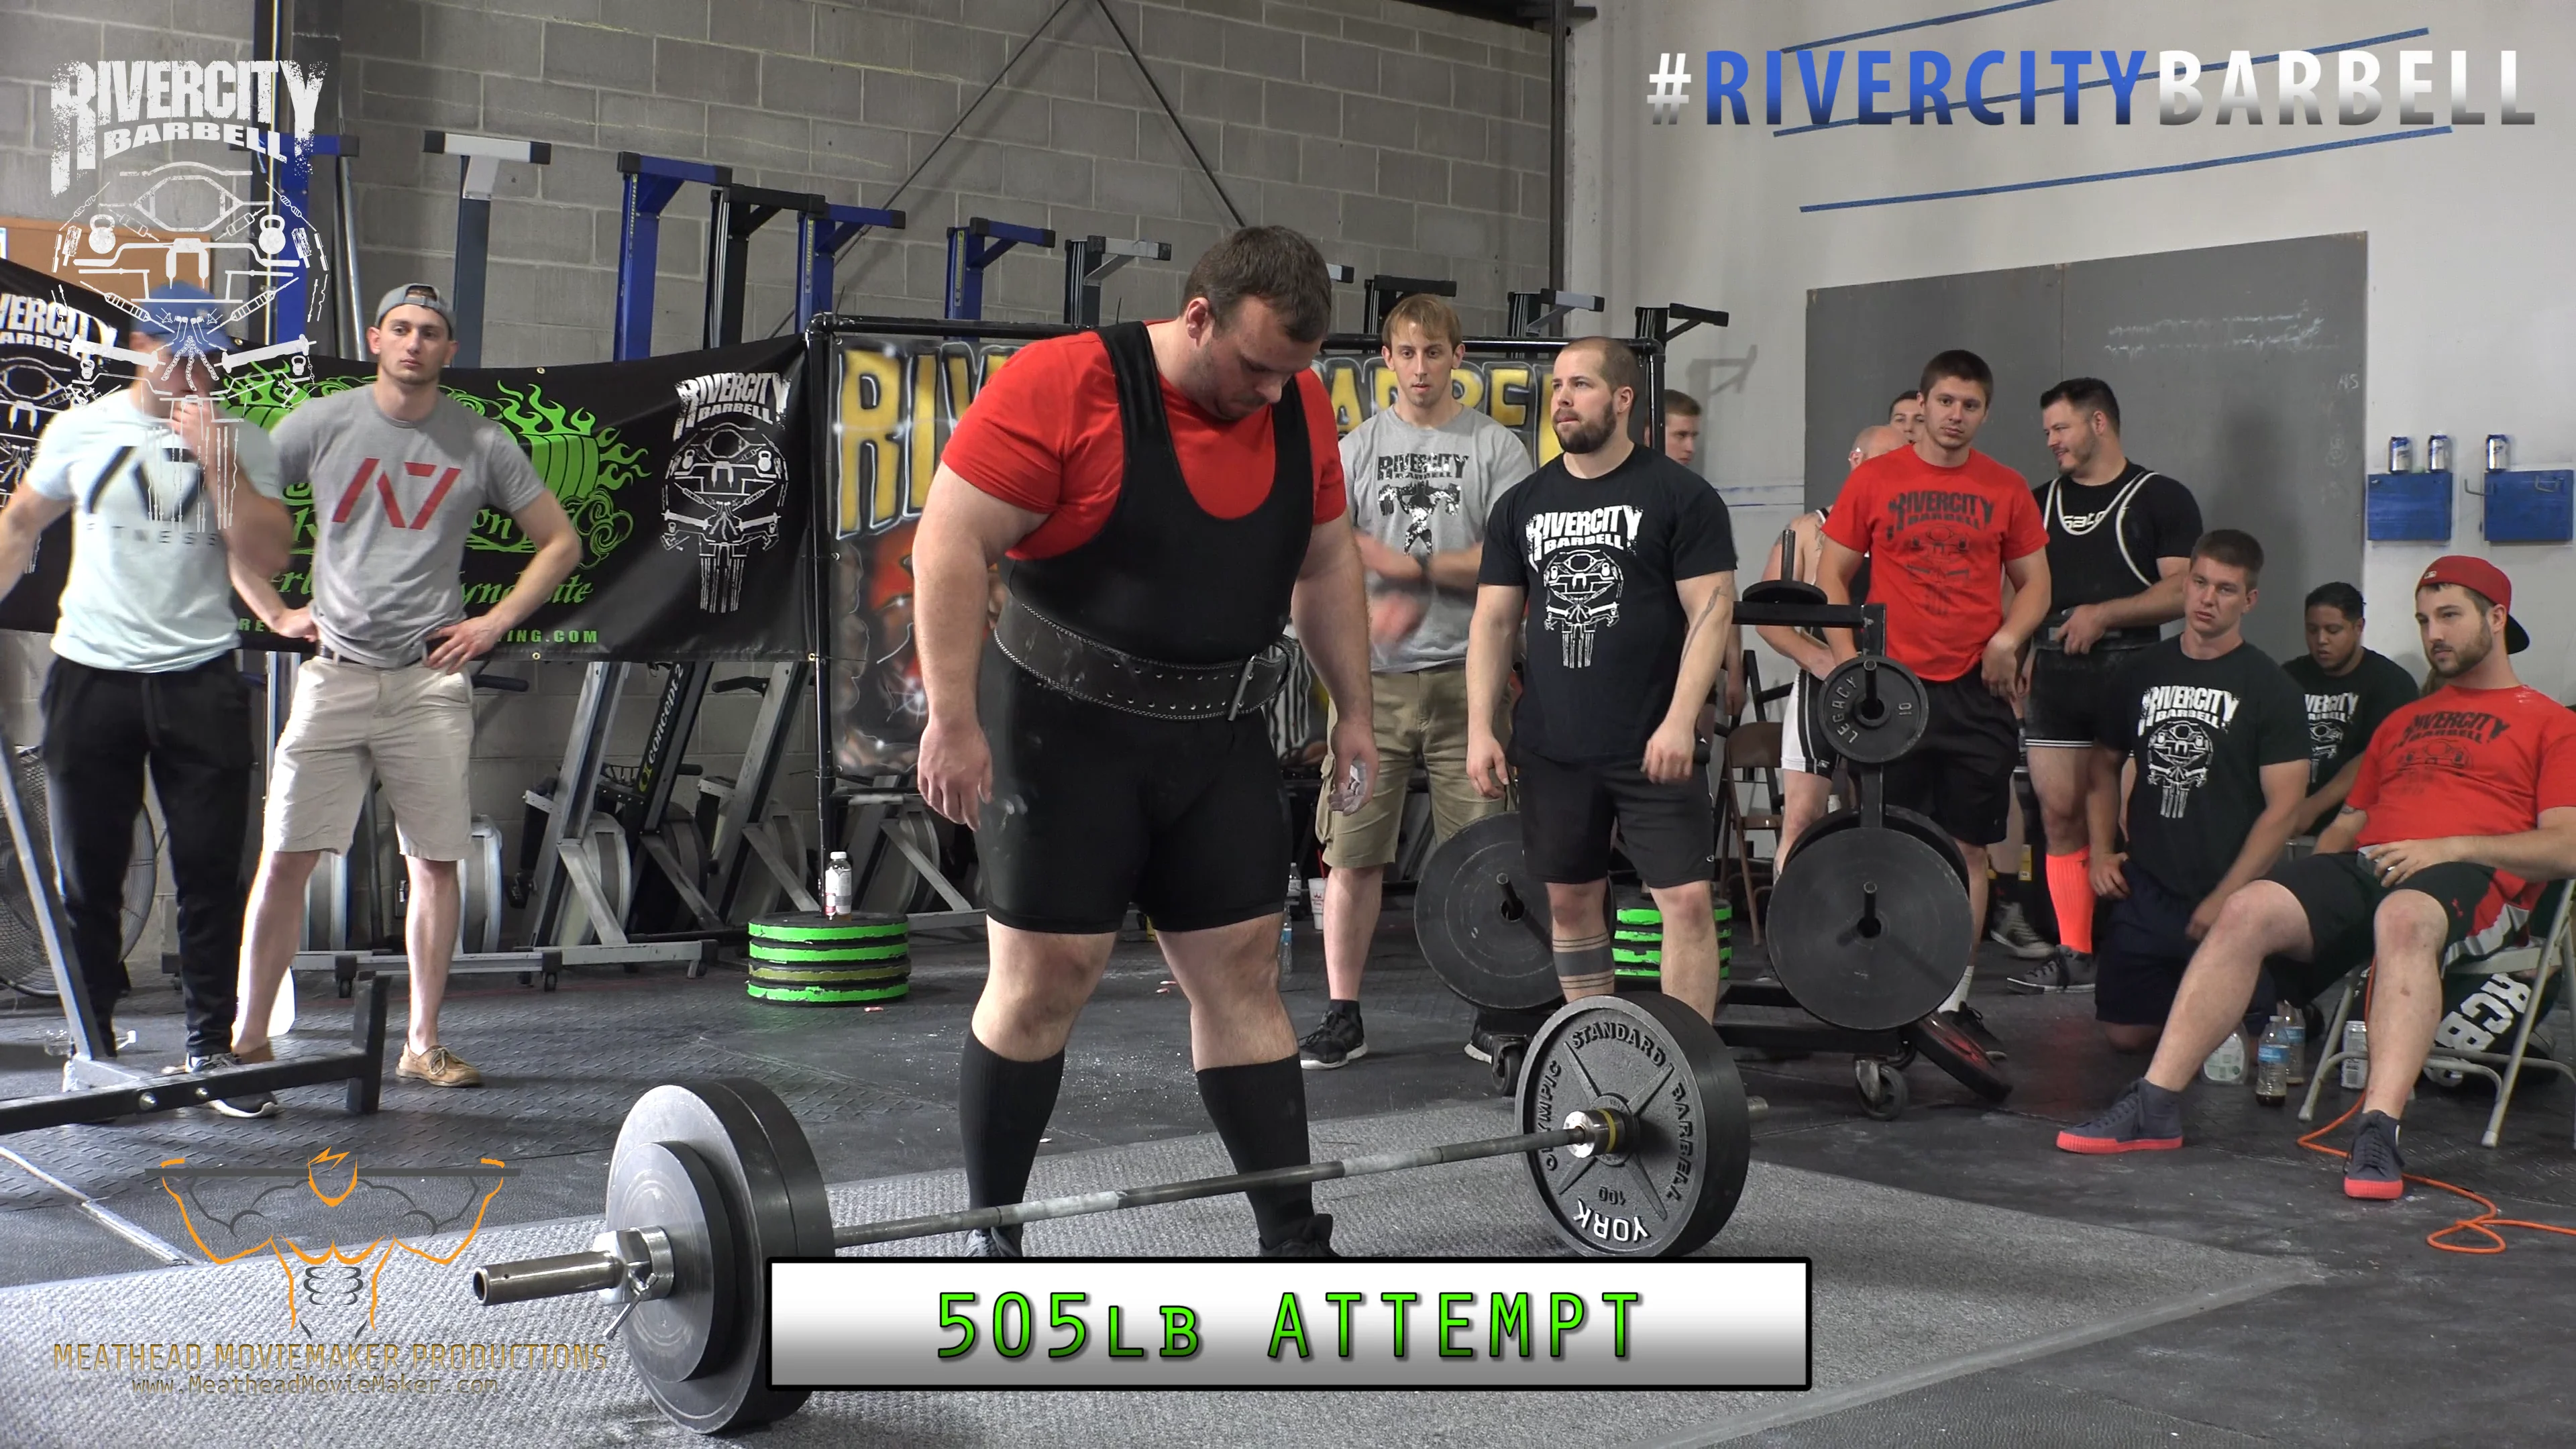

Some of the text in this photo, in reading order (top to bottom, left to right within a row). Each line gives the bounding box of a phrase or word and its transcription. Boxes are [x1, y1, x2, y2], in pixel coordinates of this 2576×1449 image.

[673, 372, 792, 442] RIVERCITY
[698, 402, 773, 425] BARBELL
[1525, 504, 1644, 574] RIVERCITY
[1544, 533, 1624, 555] BARBELL
[648, 663, 684, 764] concept 2
[1831, 676, 1858, 743] LEGACY
[1898, 702, 1912, 716] 10
[2137, 686, 2241, 737] RIVERCITY
[2155, 709, 2219, 729] BARBELL
[1572, 1022, 1667, 1067] STANDARD
[1671, 1081, 1695, 1203] BARBELL
[1599, 1186, 1627, 1206] 100
[1572, 1197, 1651, 1243] YORK
